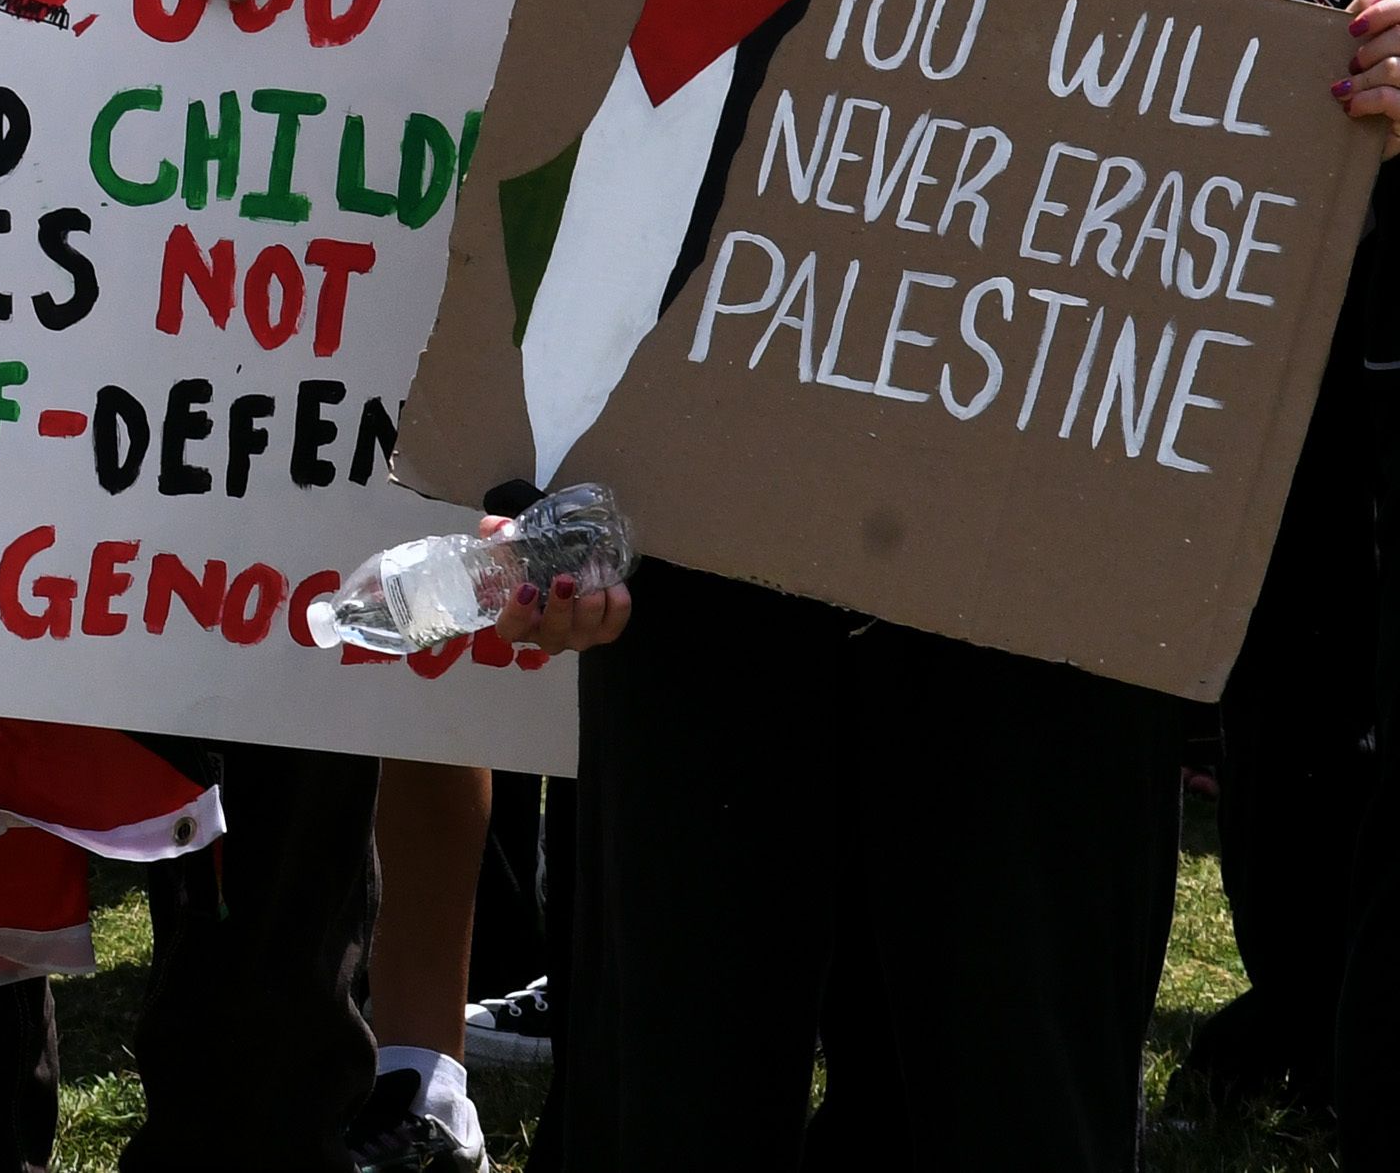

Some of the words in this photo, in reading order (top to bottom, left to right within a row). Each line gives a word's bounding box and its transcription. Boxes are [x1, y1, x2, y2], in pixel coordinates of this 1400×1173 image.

[154, 224, 376, 357] NOT
[756, 89, 1013, 248] NEVER
[1020, 141, 1300, 307] ERASE
[687, 230, 1256, 473] PALESTINE
